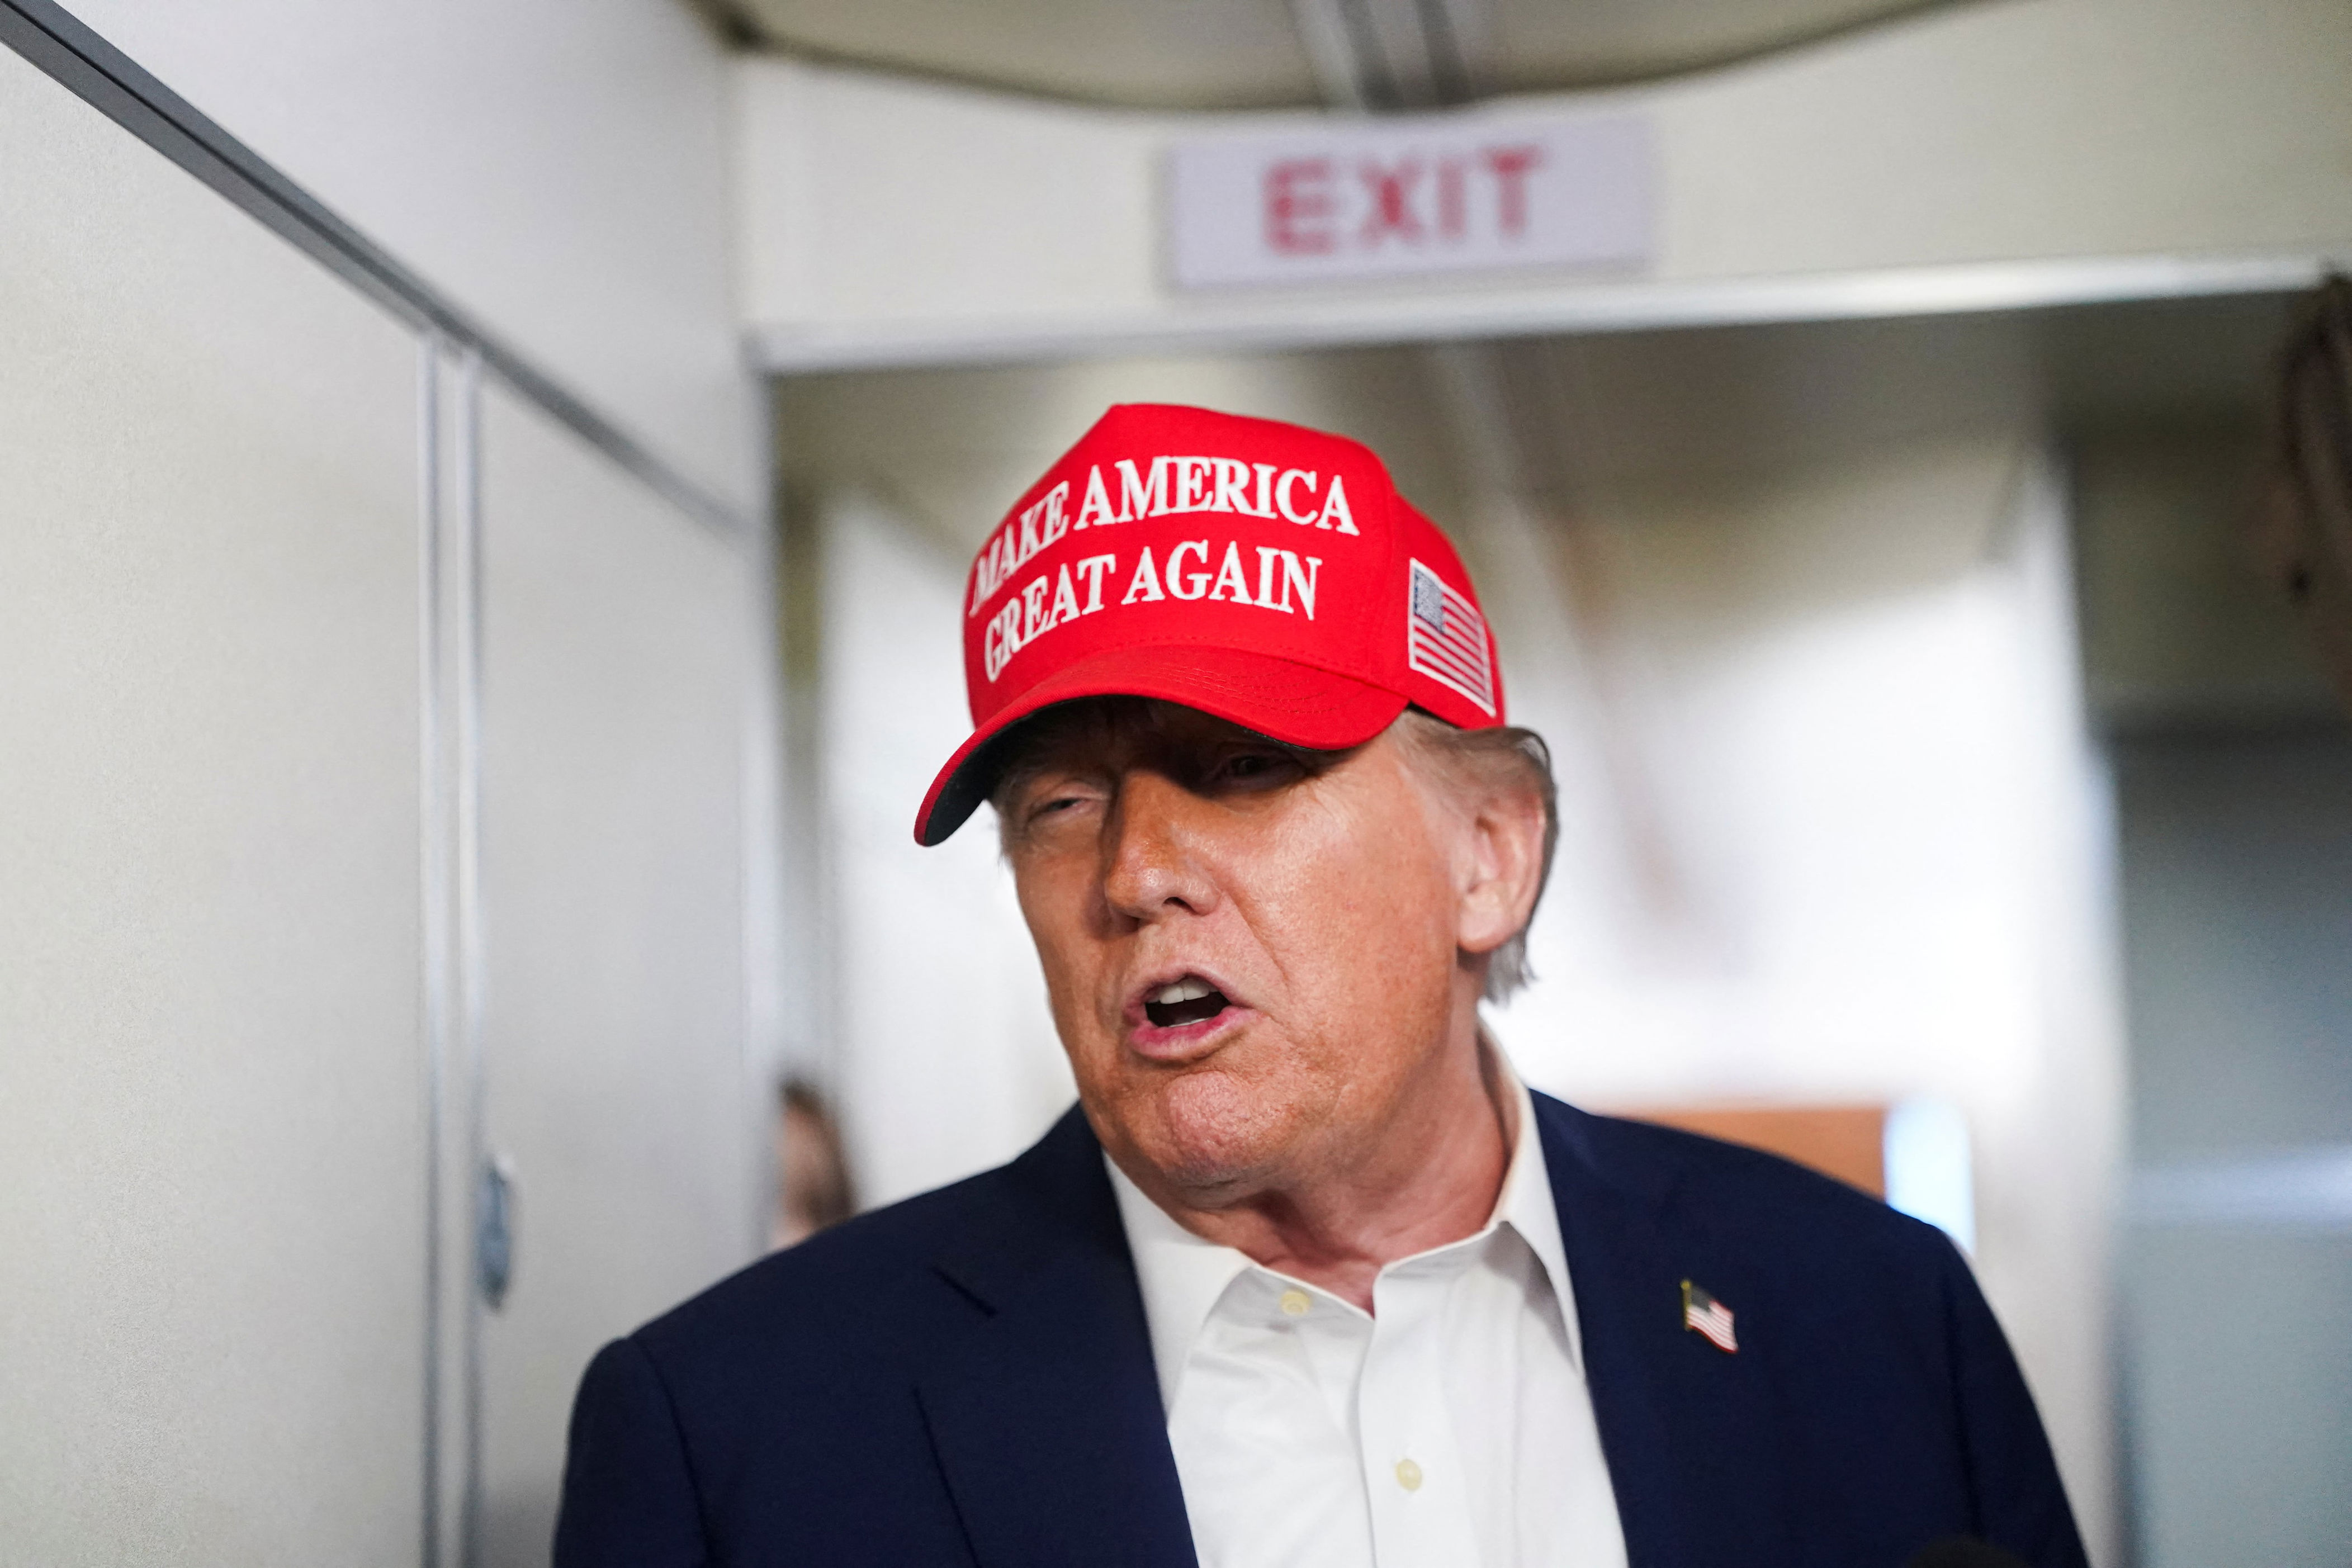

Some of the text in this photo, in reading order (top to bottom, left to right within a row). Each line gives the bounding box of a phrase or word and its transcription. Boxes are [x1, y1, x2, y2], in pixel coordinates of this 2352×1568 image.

[1261, 143, 1548, 257] EXIT
[969, 456, 1360, 617] MAKE AMERICA
[985, 539, 1322, 682] GREAT AGAIN
